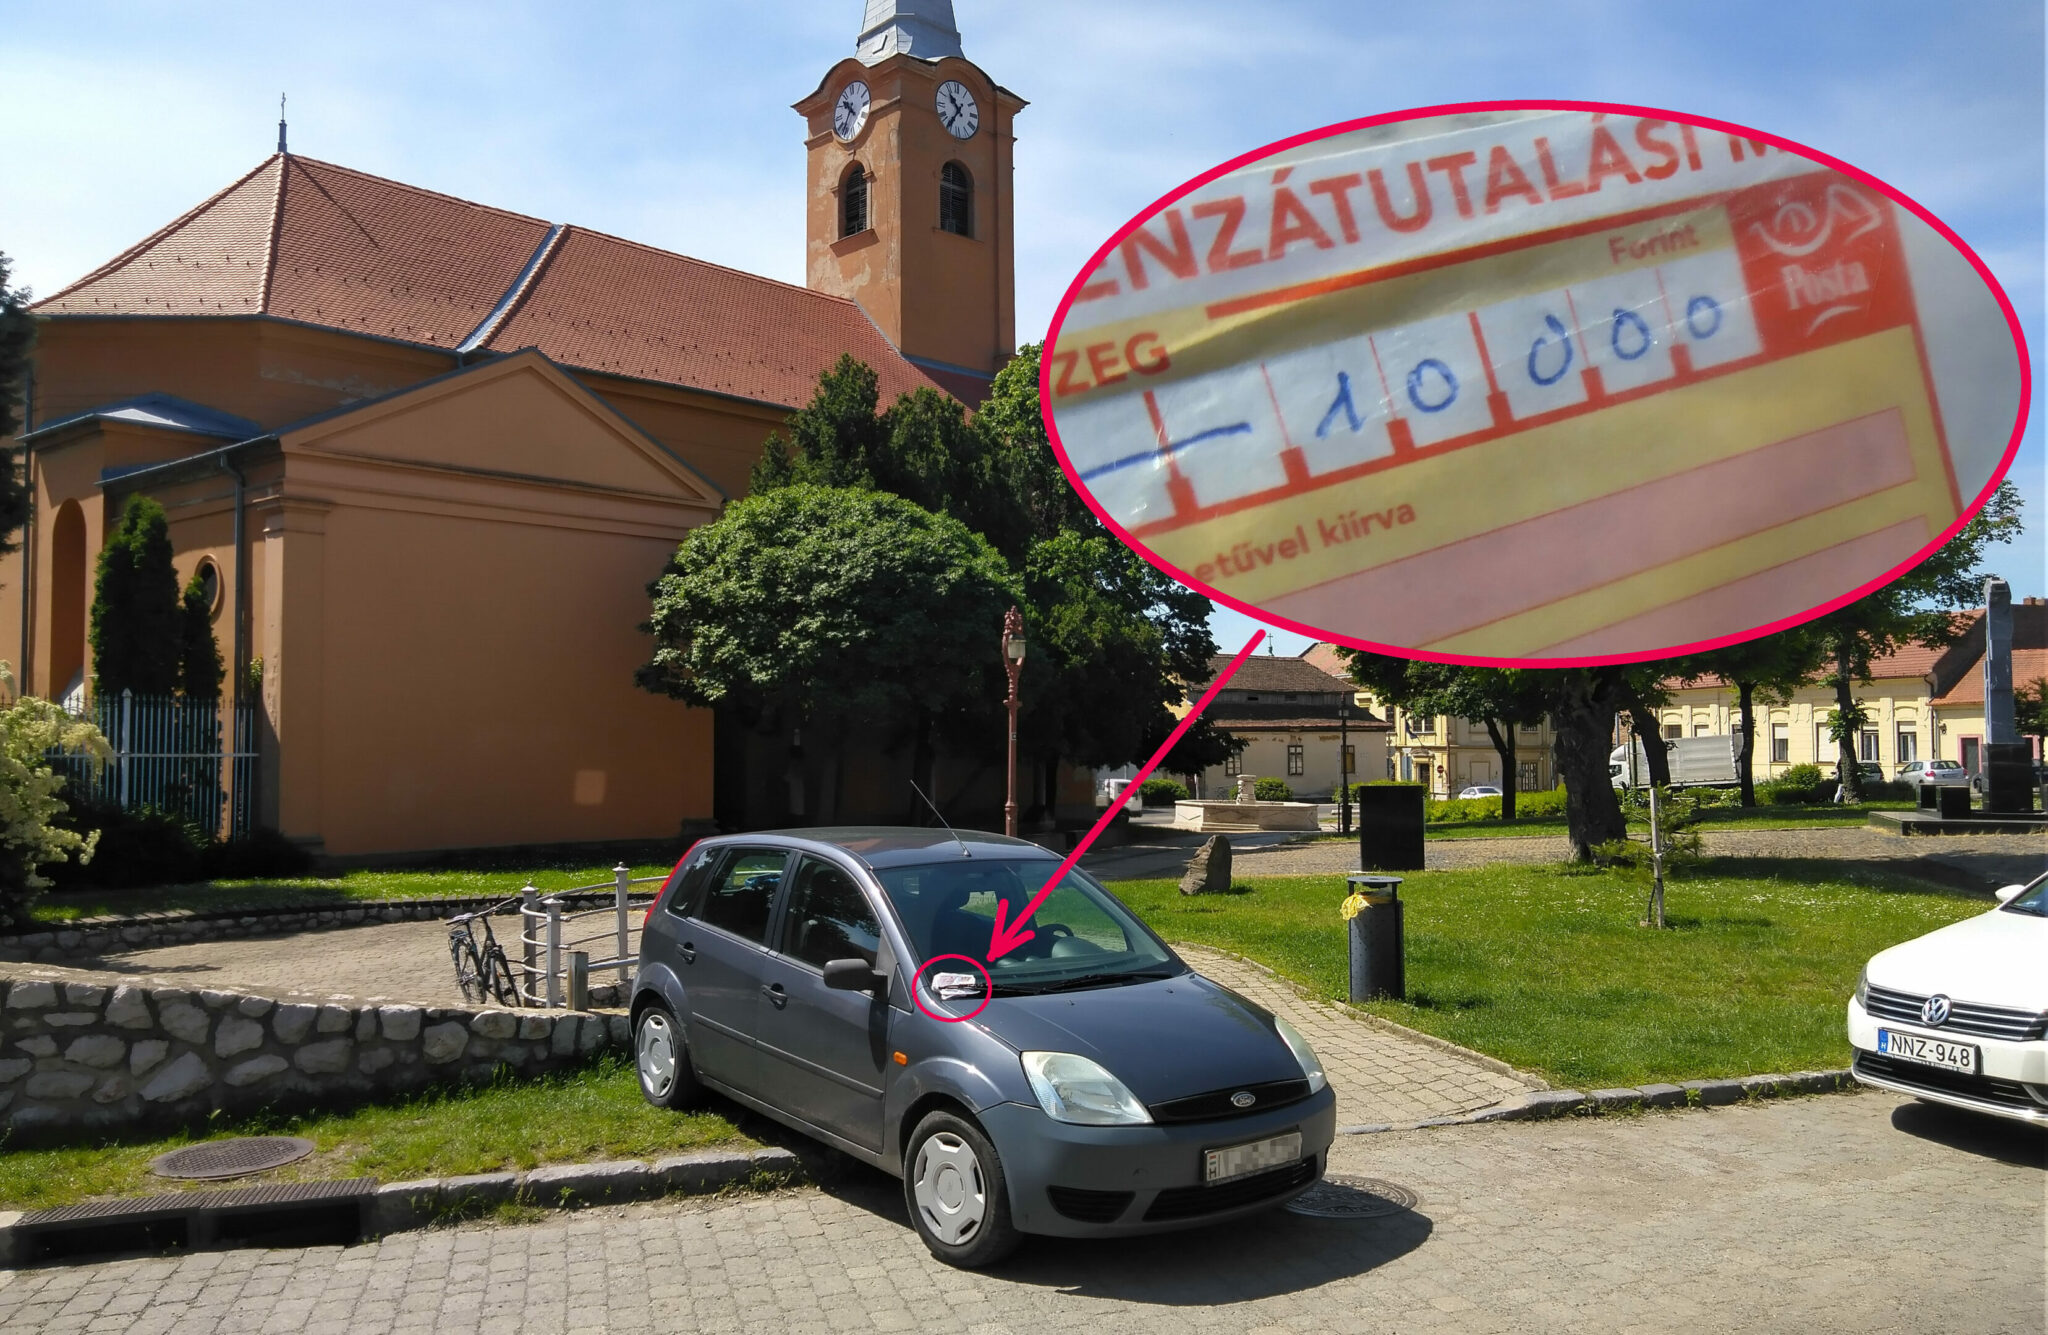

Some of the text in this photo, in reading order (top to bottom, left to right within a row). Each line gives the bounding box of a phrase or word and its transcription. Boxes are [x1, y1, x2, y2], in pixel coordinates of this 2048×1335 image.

[1608, 223, 1699, 265] Forint
[1780, 259, 1870, 311] Posta
[1051, 331, 1172, 397] ZEG
[1181, 502, 1416, 583] etűvel kiírva
[1891, 1034, 1970, 1067] NNZ-948
[1208, 1166, 1218, 1180] H
